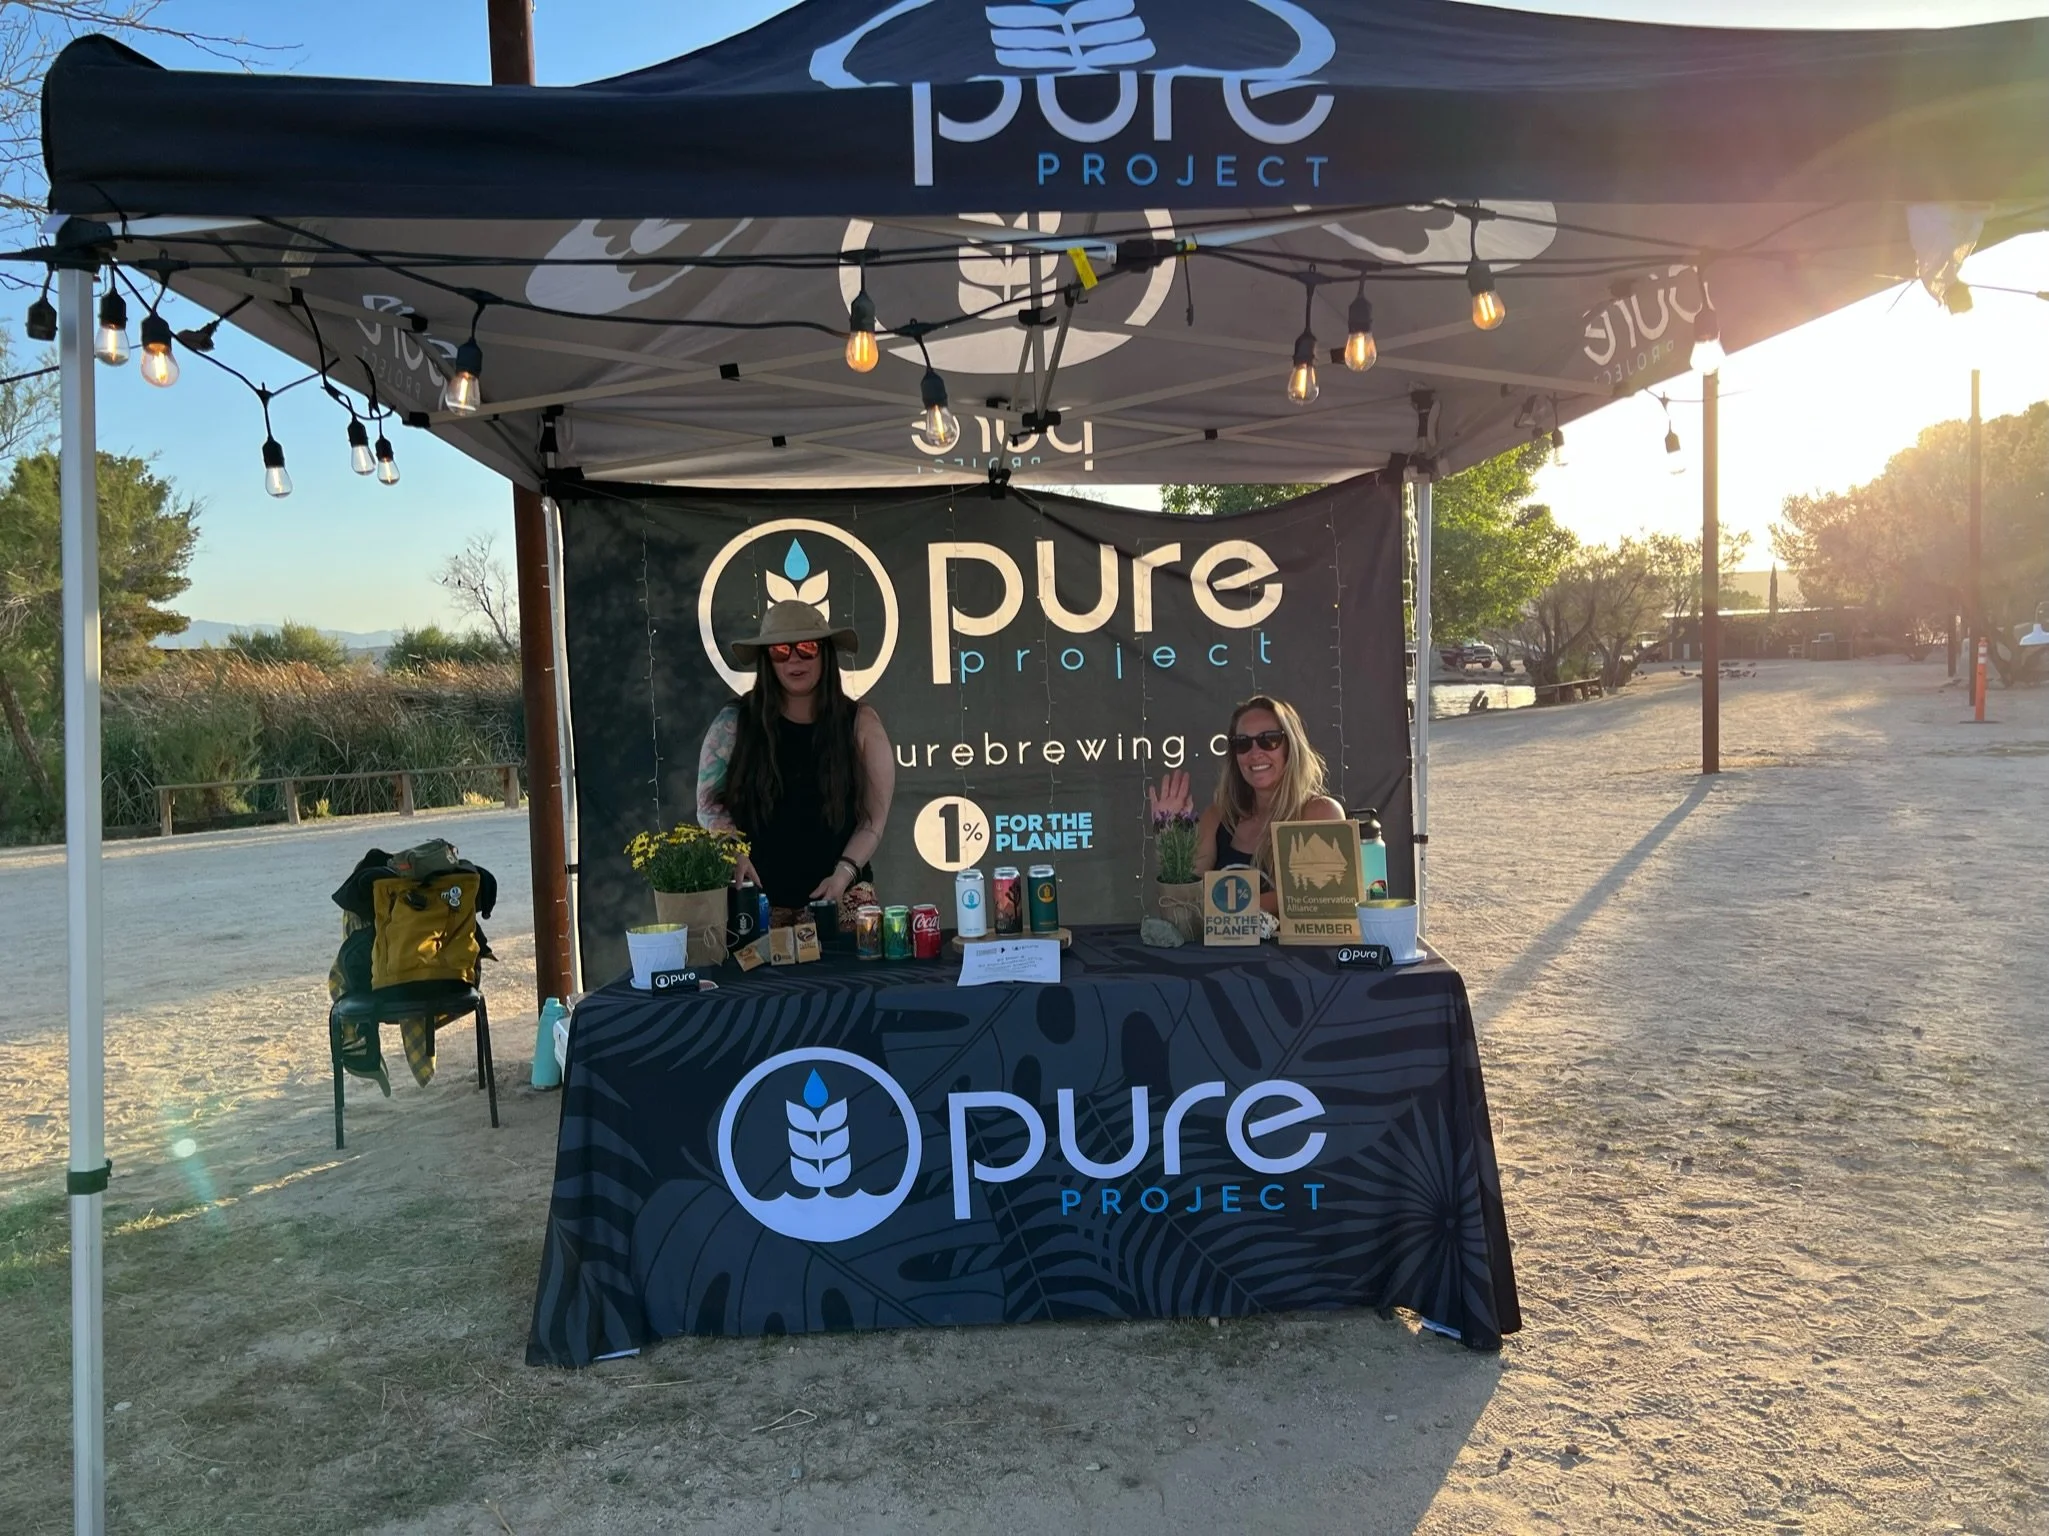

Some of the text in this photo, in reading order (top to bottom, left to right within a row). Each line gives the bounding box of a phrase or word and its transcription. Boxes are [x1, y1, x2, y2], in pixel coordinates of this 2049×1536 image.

[912, 70, 1335, 187] pure
[1037, 152, 1329, 187] PROJECT
[928, 539, 1284, 685] pure
[960, 631, 1272, 684] project
[896, 732, 1228, 769] urebrewing.c
[995, 812, 1093, 833] FOR THE
[995, 831, 1093, 852] PLANET
[1286, 895, 1357, 905] The Conservation
[1286, 903, 1318, 913] Alliance
[1206, 915, 1258, 925] FOR THE
[1206, 925, 1258, 935] PLANET
[1294, 923, 1353, 935] MEMBER
[1352, 949, 1378, 961] pure
[670, 971, 696, 988] pure
[948, 1079, 1327, 1220] pure
[1061, 1184, 1326, 1216] PROJECT
